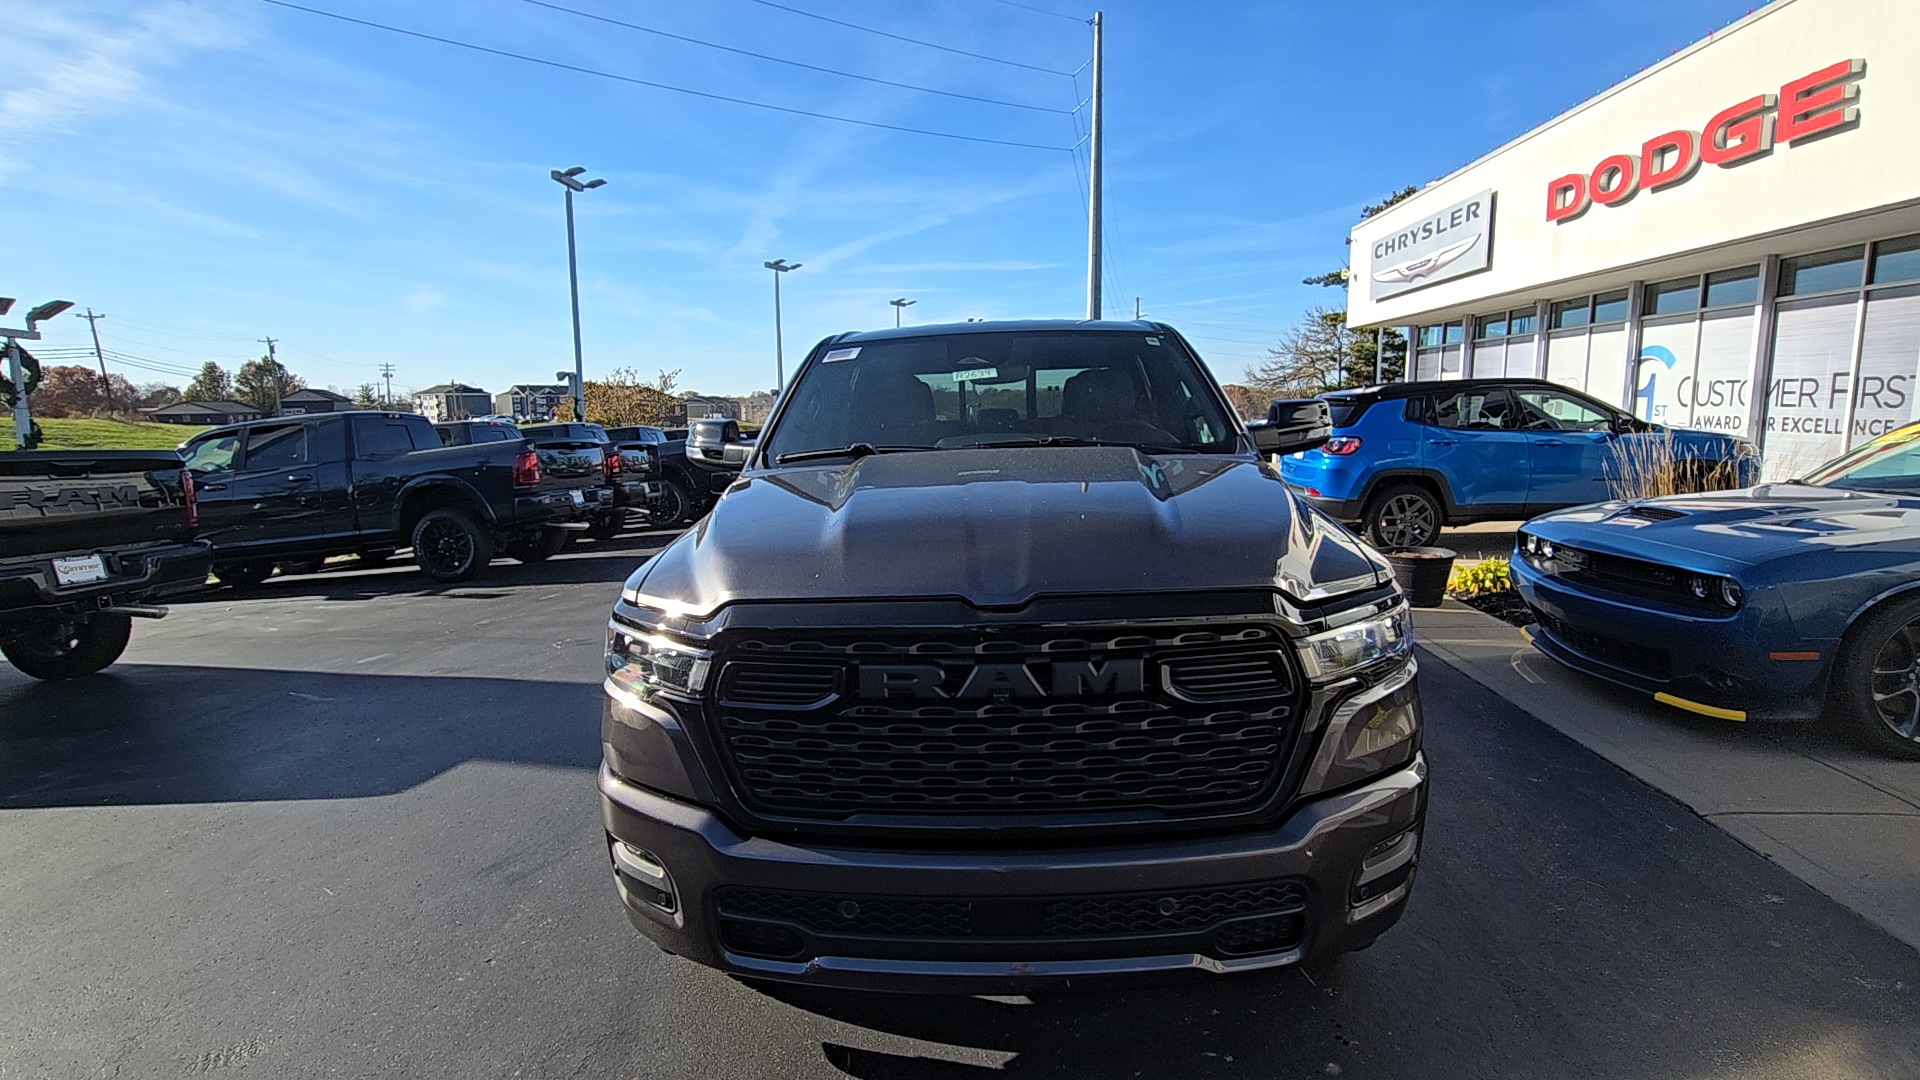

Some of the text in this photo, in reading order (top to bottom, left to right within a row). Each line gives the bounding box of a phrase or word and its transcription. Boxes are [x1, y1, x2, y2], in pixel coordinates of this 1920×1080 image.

[1546, 58, 1866, 225] DODGE
[1375, 201, 1480, 259] CHRYSLER
[1829, 371, 1916, 410] FRS
[1694, 415, 1742, 430] AWARD
[1781, 416, 1895, 436] EXCELLNCE
[0, 485, 140, 510] RAM
[859, 659, 1144, 698] RAM
